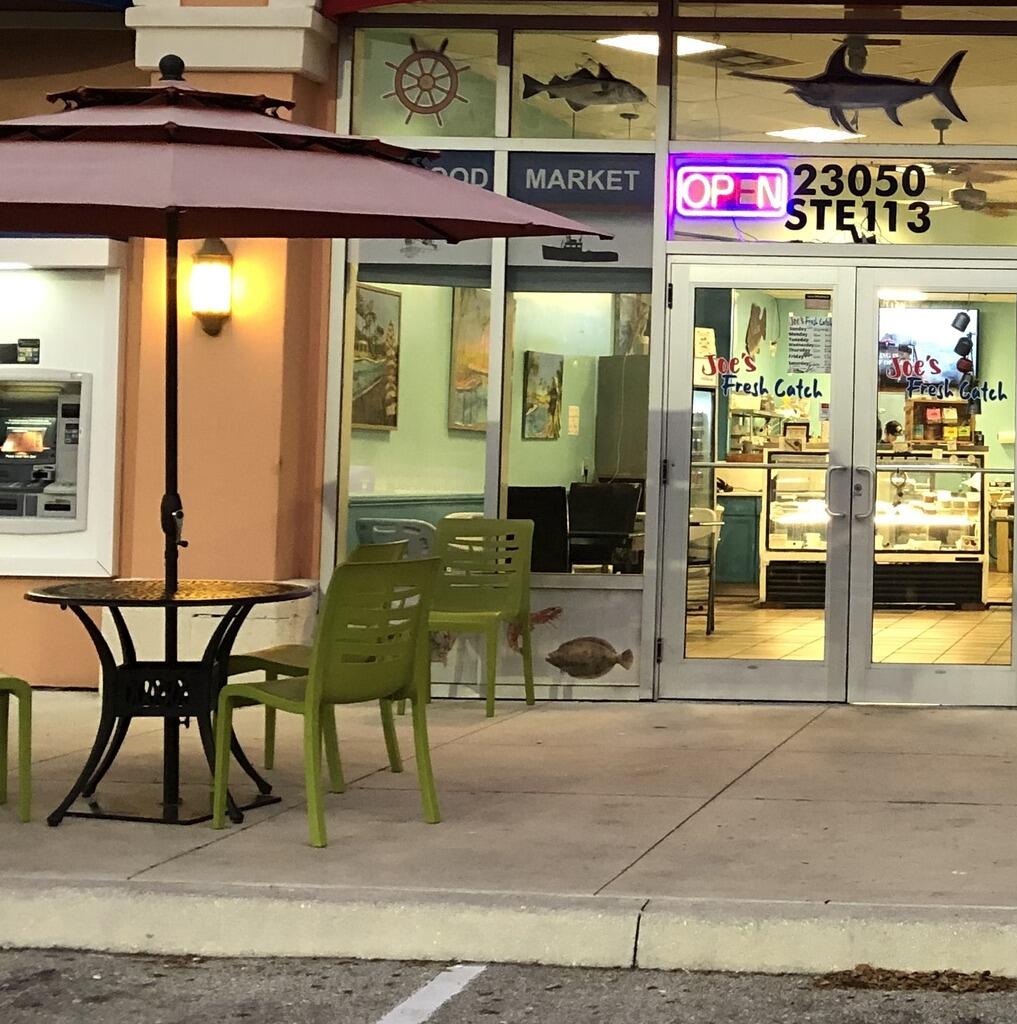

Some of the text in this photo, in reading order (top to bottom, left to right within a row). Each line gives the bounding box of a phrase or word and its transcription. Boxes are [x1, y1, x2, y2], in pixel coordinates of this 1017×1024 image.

[525, 168, 640, 191] MARKET
[682, 173, 784, 209] OPEN
[793, 164, 926, 197] 23050
[702, 353, 757, 375] Joe's
[887, 355, 941, 378] Joe's
[721, 374, 823, 399] Fresh Catch
[906, 377, 1008, 402] Fresh Catch
